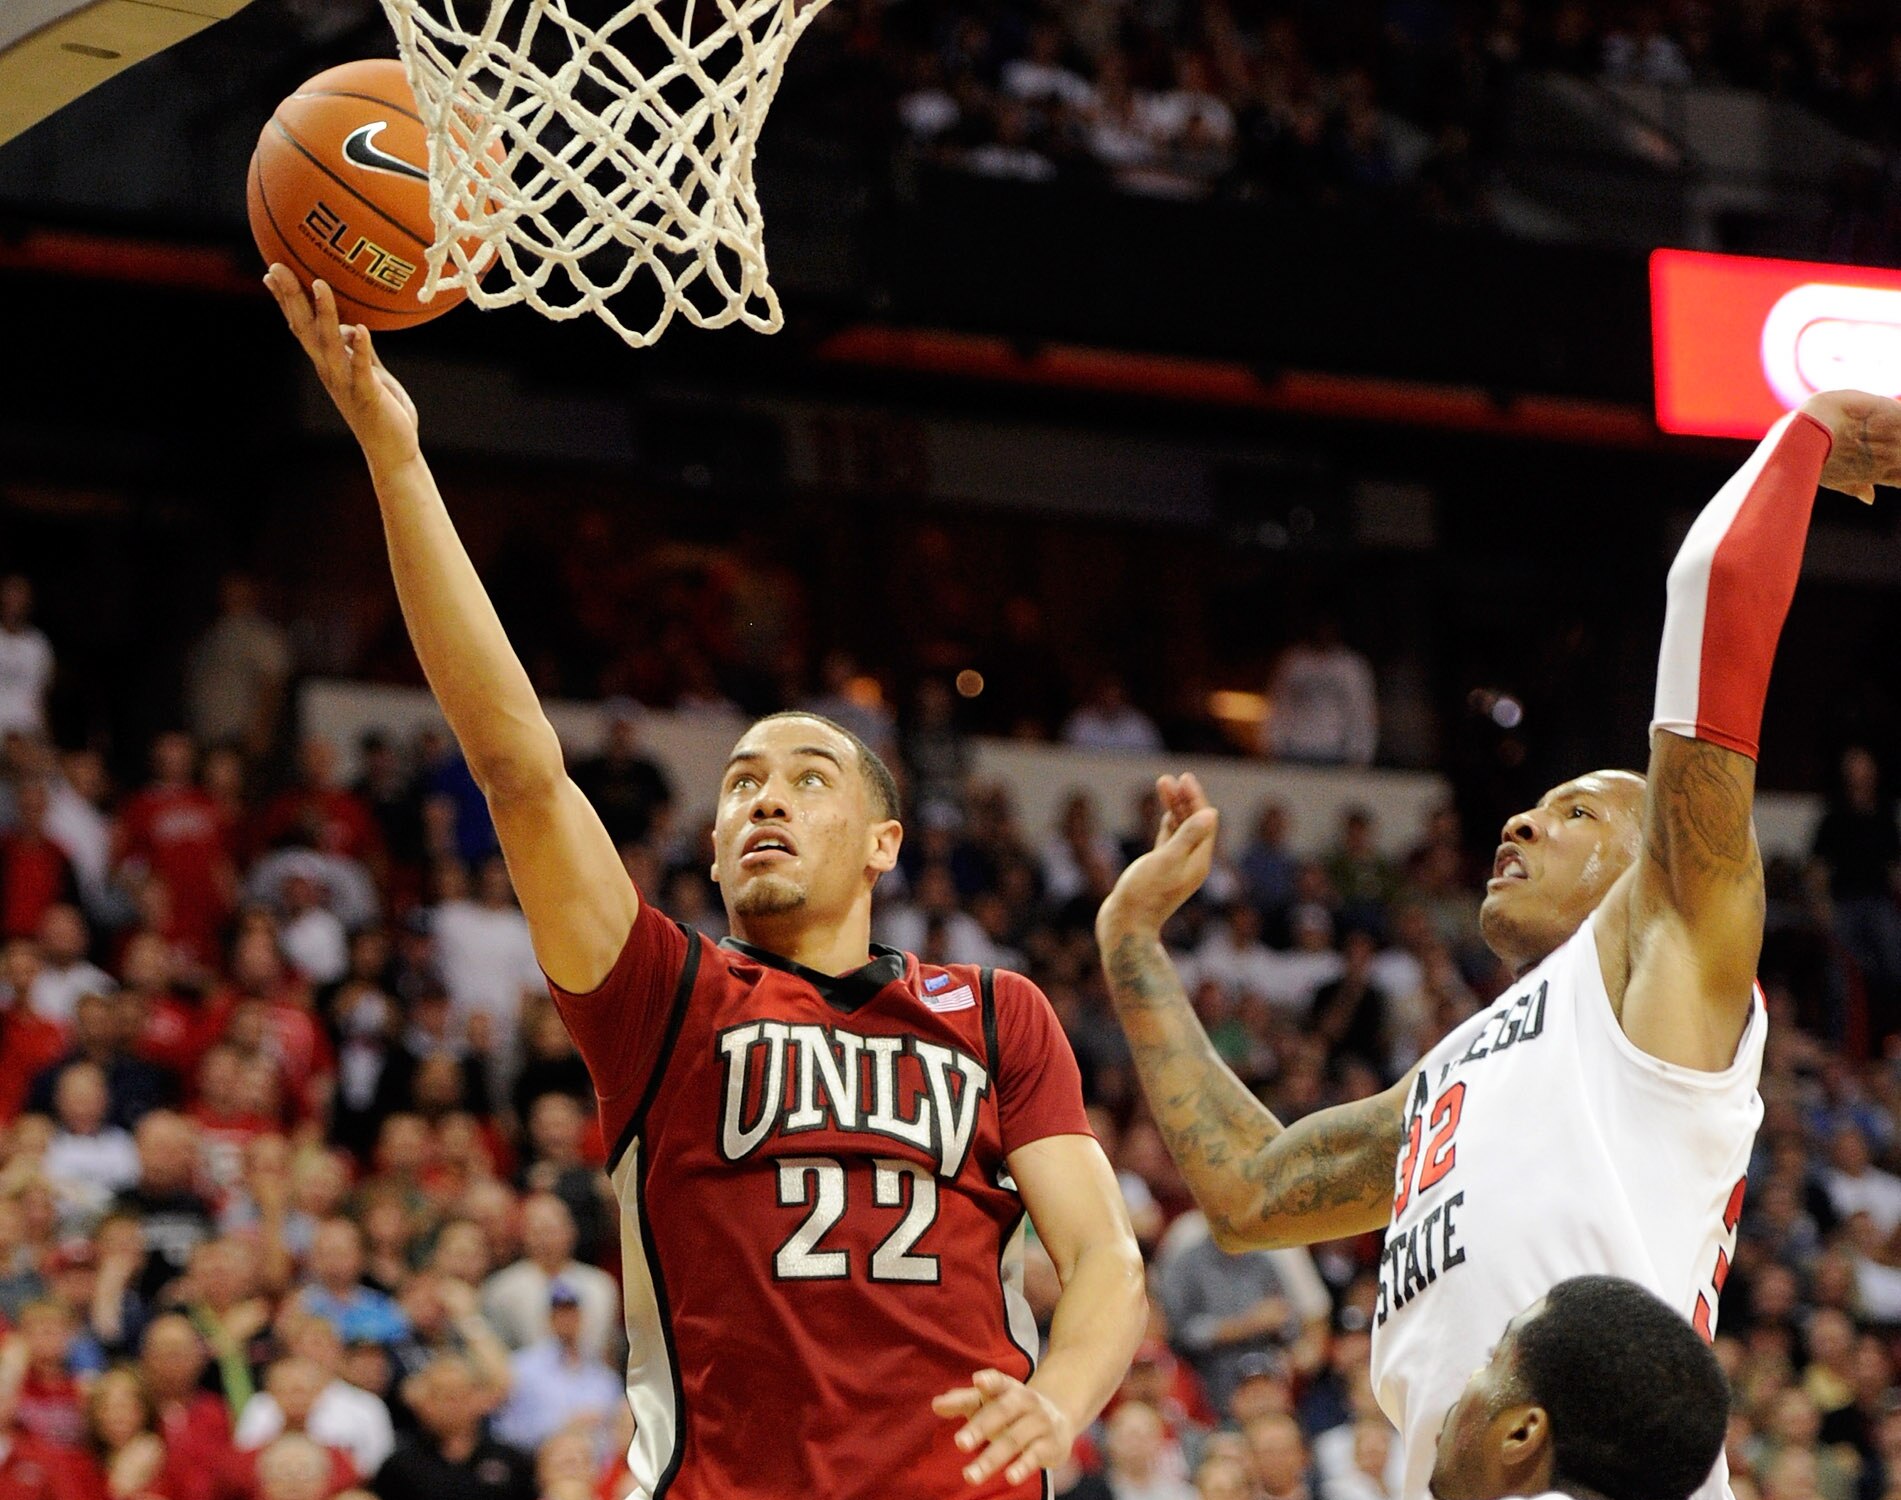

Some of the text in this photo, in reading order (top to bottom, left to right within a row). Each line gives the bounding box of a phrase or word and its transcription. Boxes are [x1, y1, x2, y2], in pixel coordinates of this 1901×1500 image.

[304, 199, 417, 291] ELITE
[716, 1017, 992, 1182] UNLV
[772, 1154, 942, 1284] 22
[1377, 1190, 1467, 1329] STATE
